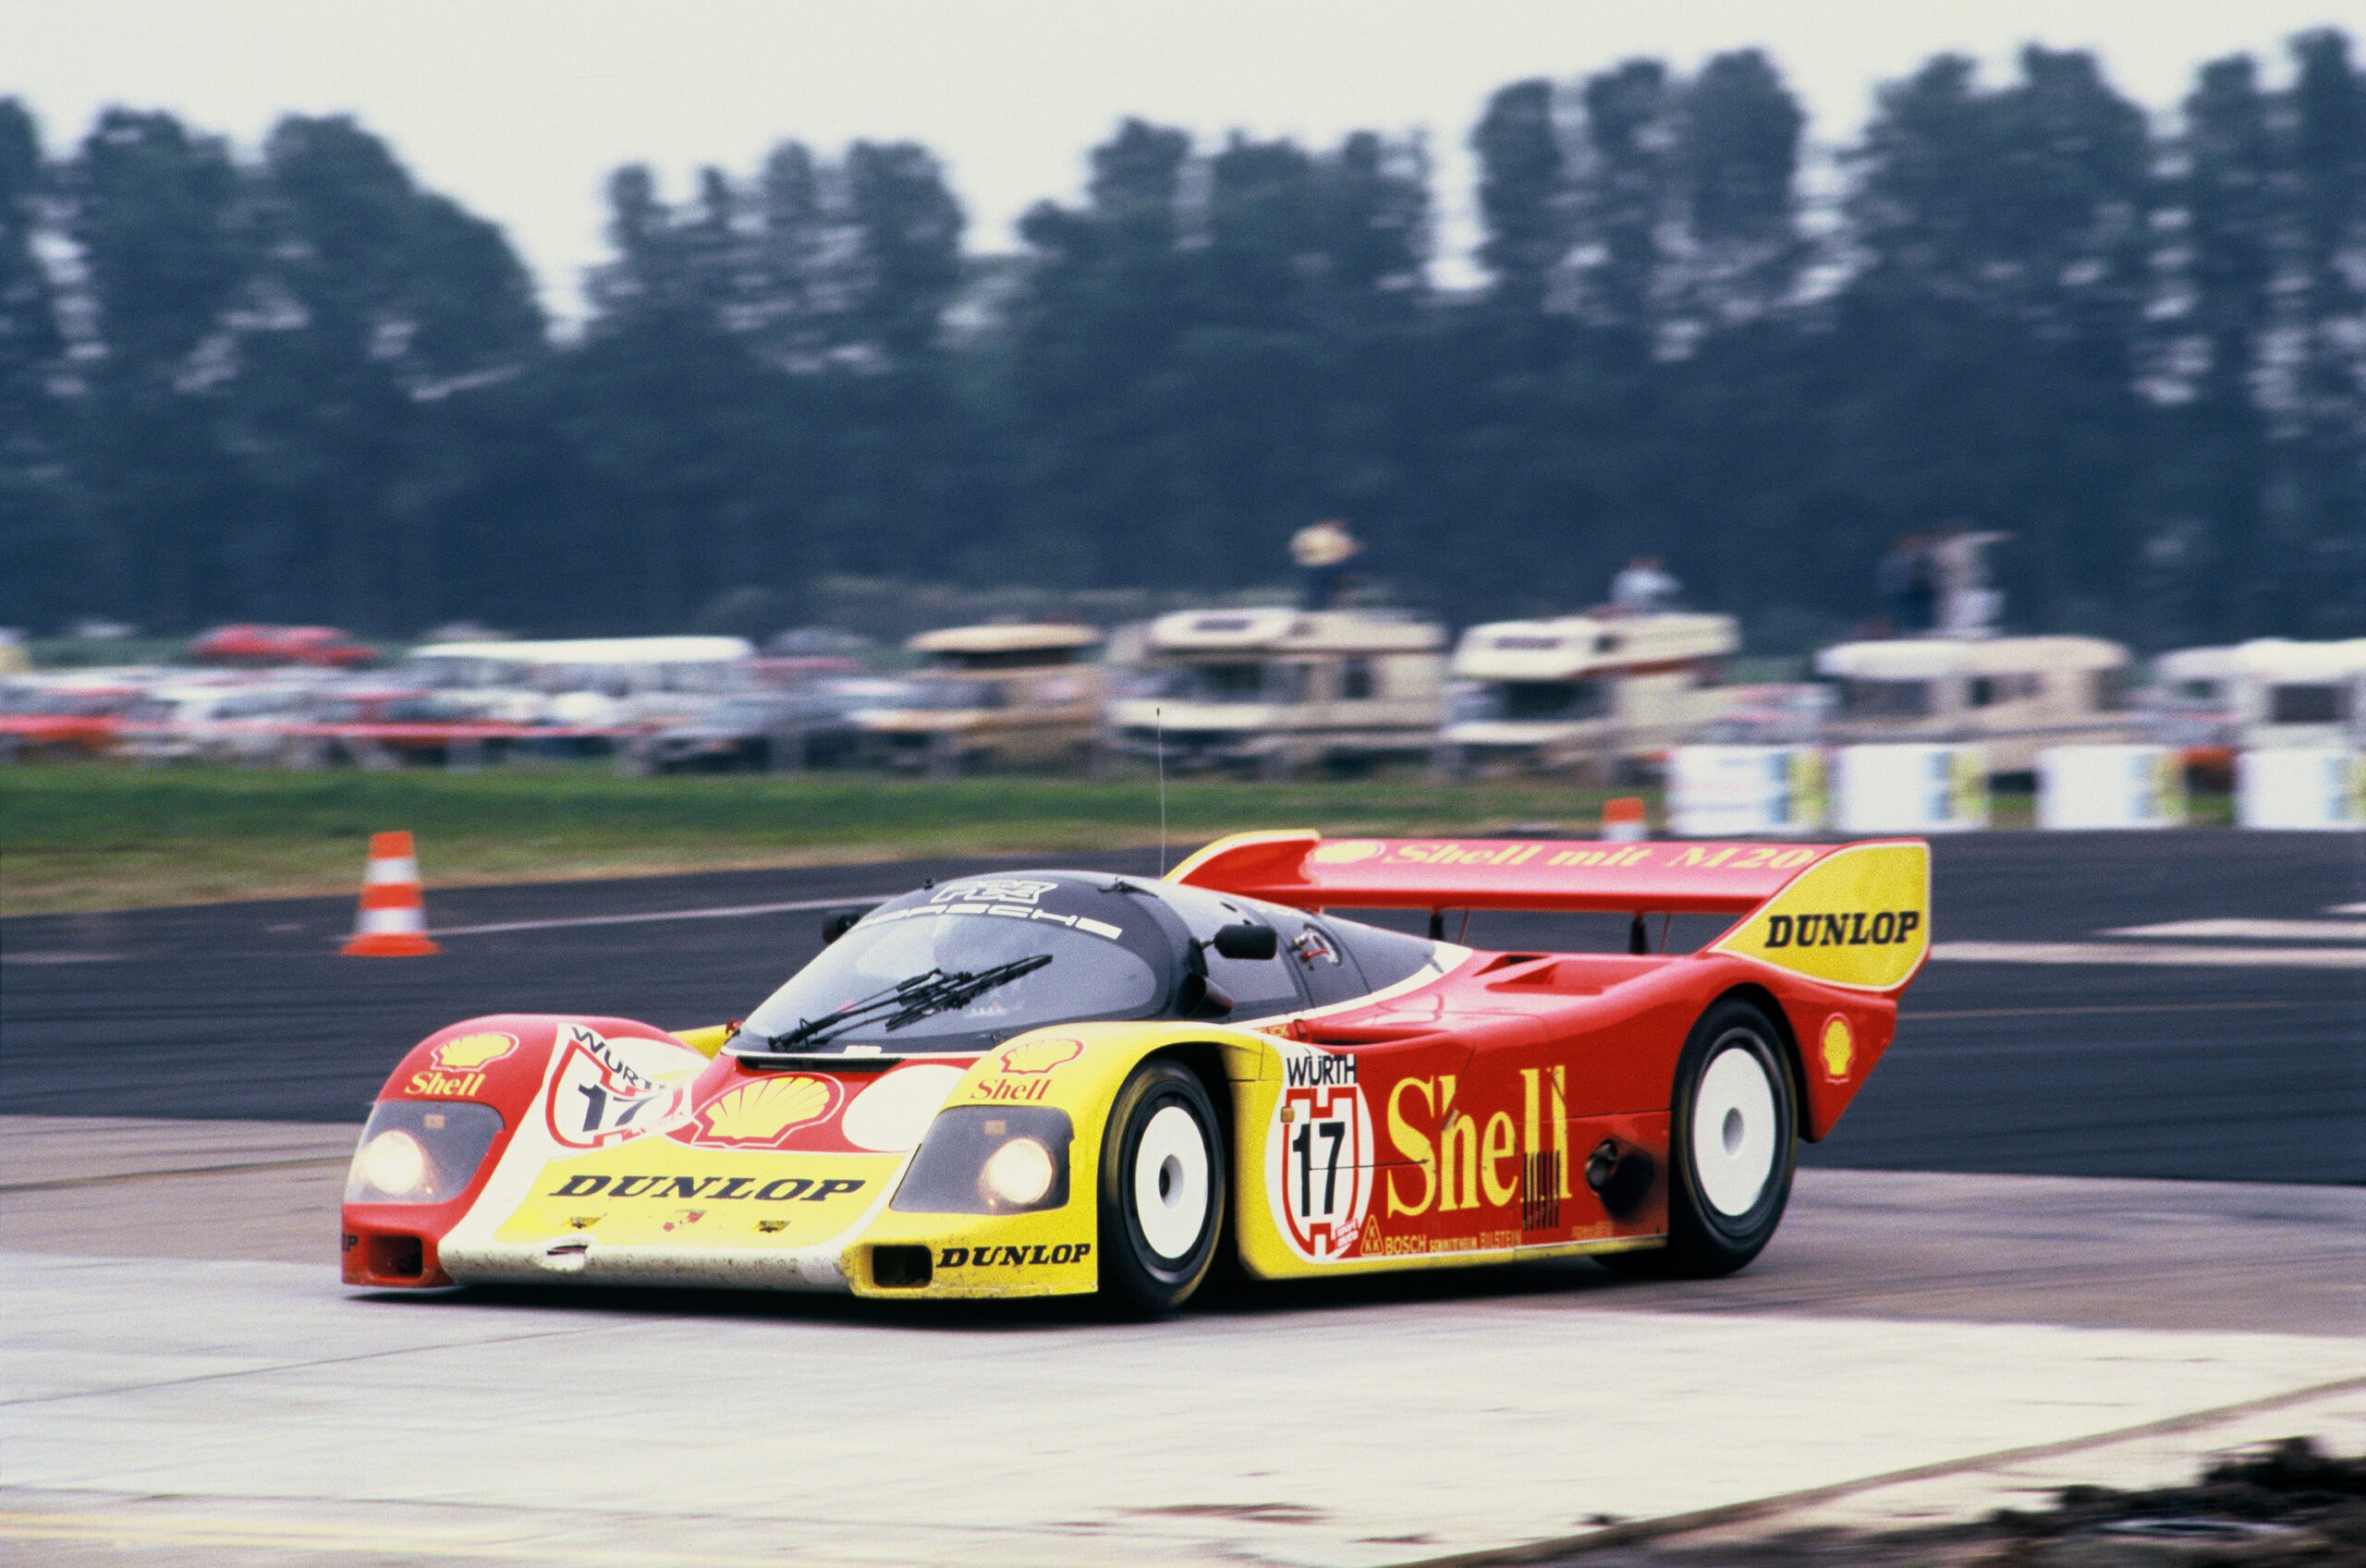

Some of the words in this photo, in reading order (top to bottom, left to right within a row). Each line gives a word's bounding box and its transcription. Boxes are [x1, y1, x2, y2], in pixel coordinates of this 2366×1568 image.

[1384, 844, 1543, 866] Shell
[1547, 845, 1653, 868] mit
[1764, 910, 1920, 948] DUNLOP
[405, 1071, 486, 1098] Shell
[970, 1078, 1053, 1101] Shell
[568, 1083, 659, 1132] 17
[1387, 1064, 1572, 1219] Shell
[1292, 1121, 1346, 1218] 17
[547, 1174, 866, 1202] DUNLOP
[935, 1243, 1092, 1269] DUNLOP
[1385, 1234, 1428, 1256] BOSCH
